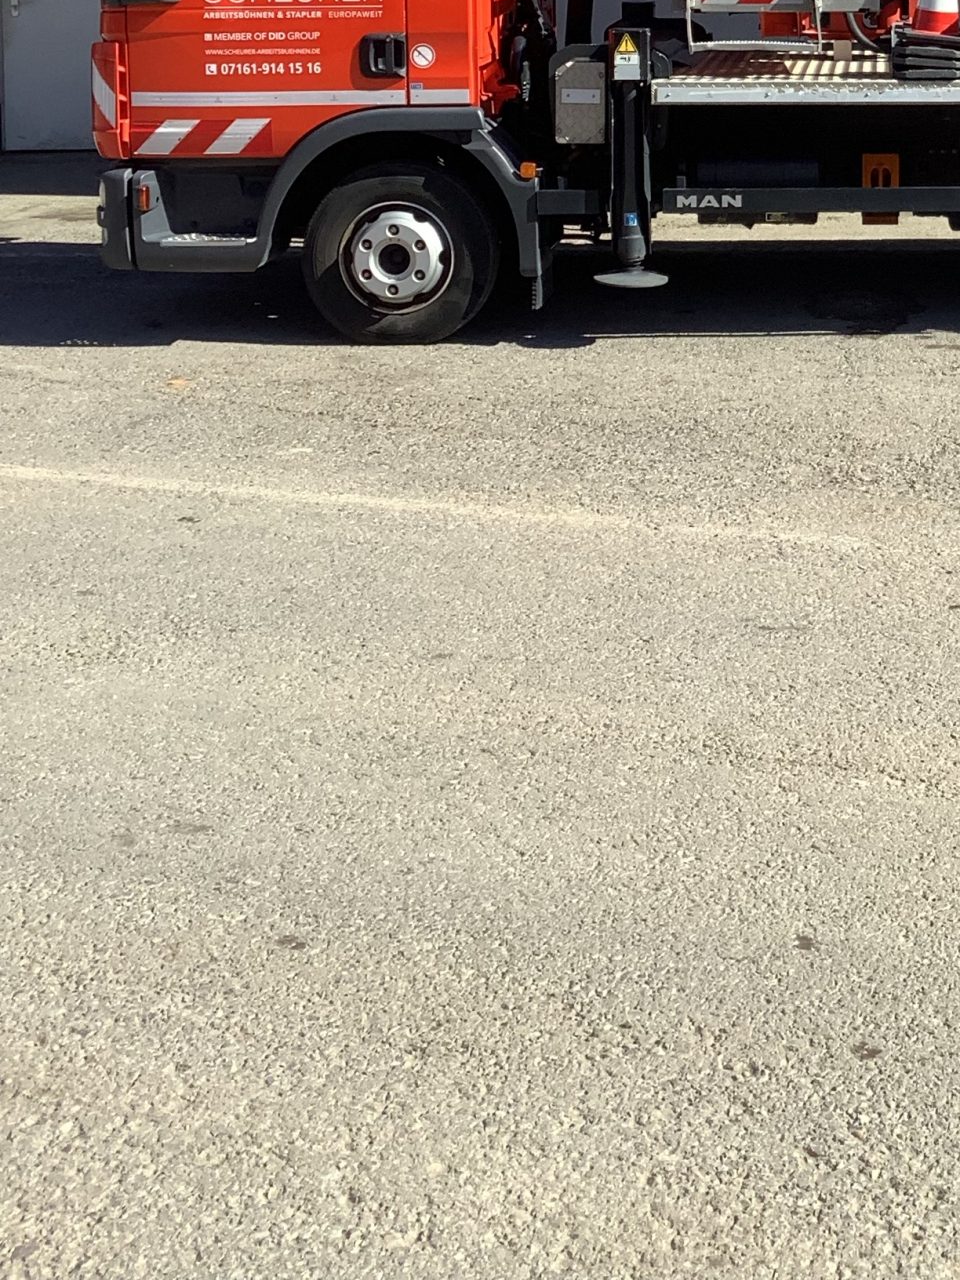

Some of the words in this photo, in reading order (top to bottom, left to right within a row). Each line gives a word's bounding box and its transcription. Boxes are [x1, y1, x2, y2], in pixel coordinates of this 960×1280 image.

[203, 10, 275, 19] ARBEITSBÜHNEN
[276, 11, 284, 19] &
[213, 33, 252, 41] MEMBER
[268, 33, 286, 41] DID
[287, 32, 321, 40] GROUP
[220, 63, 285, 75] 07161-914
[288, 63, 303, 74] 15
[307, 62, 322, 74] 16
[676, 194, 743, 208] MAN
